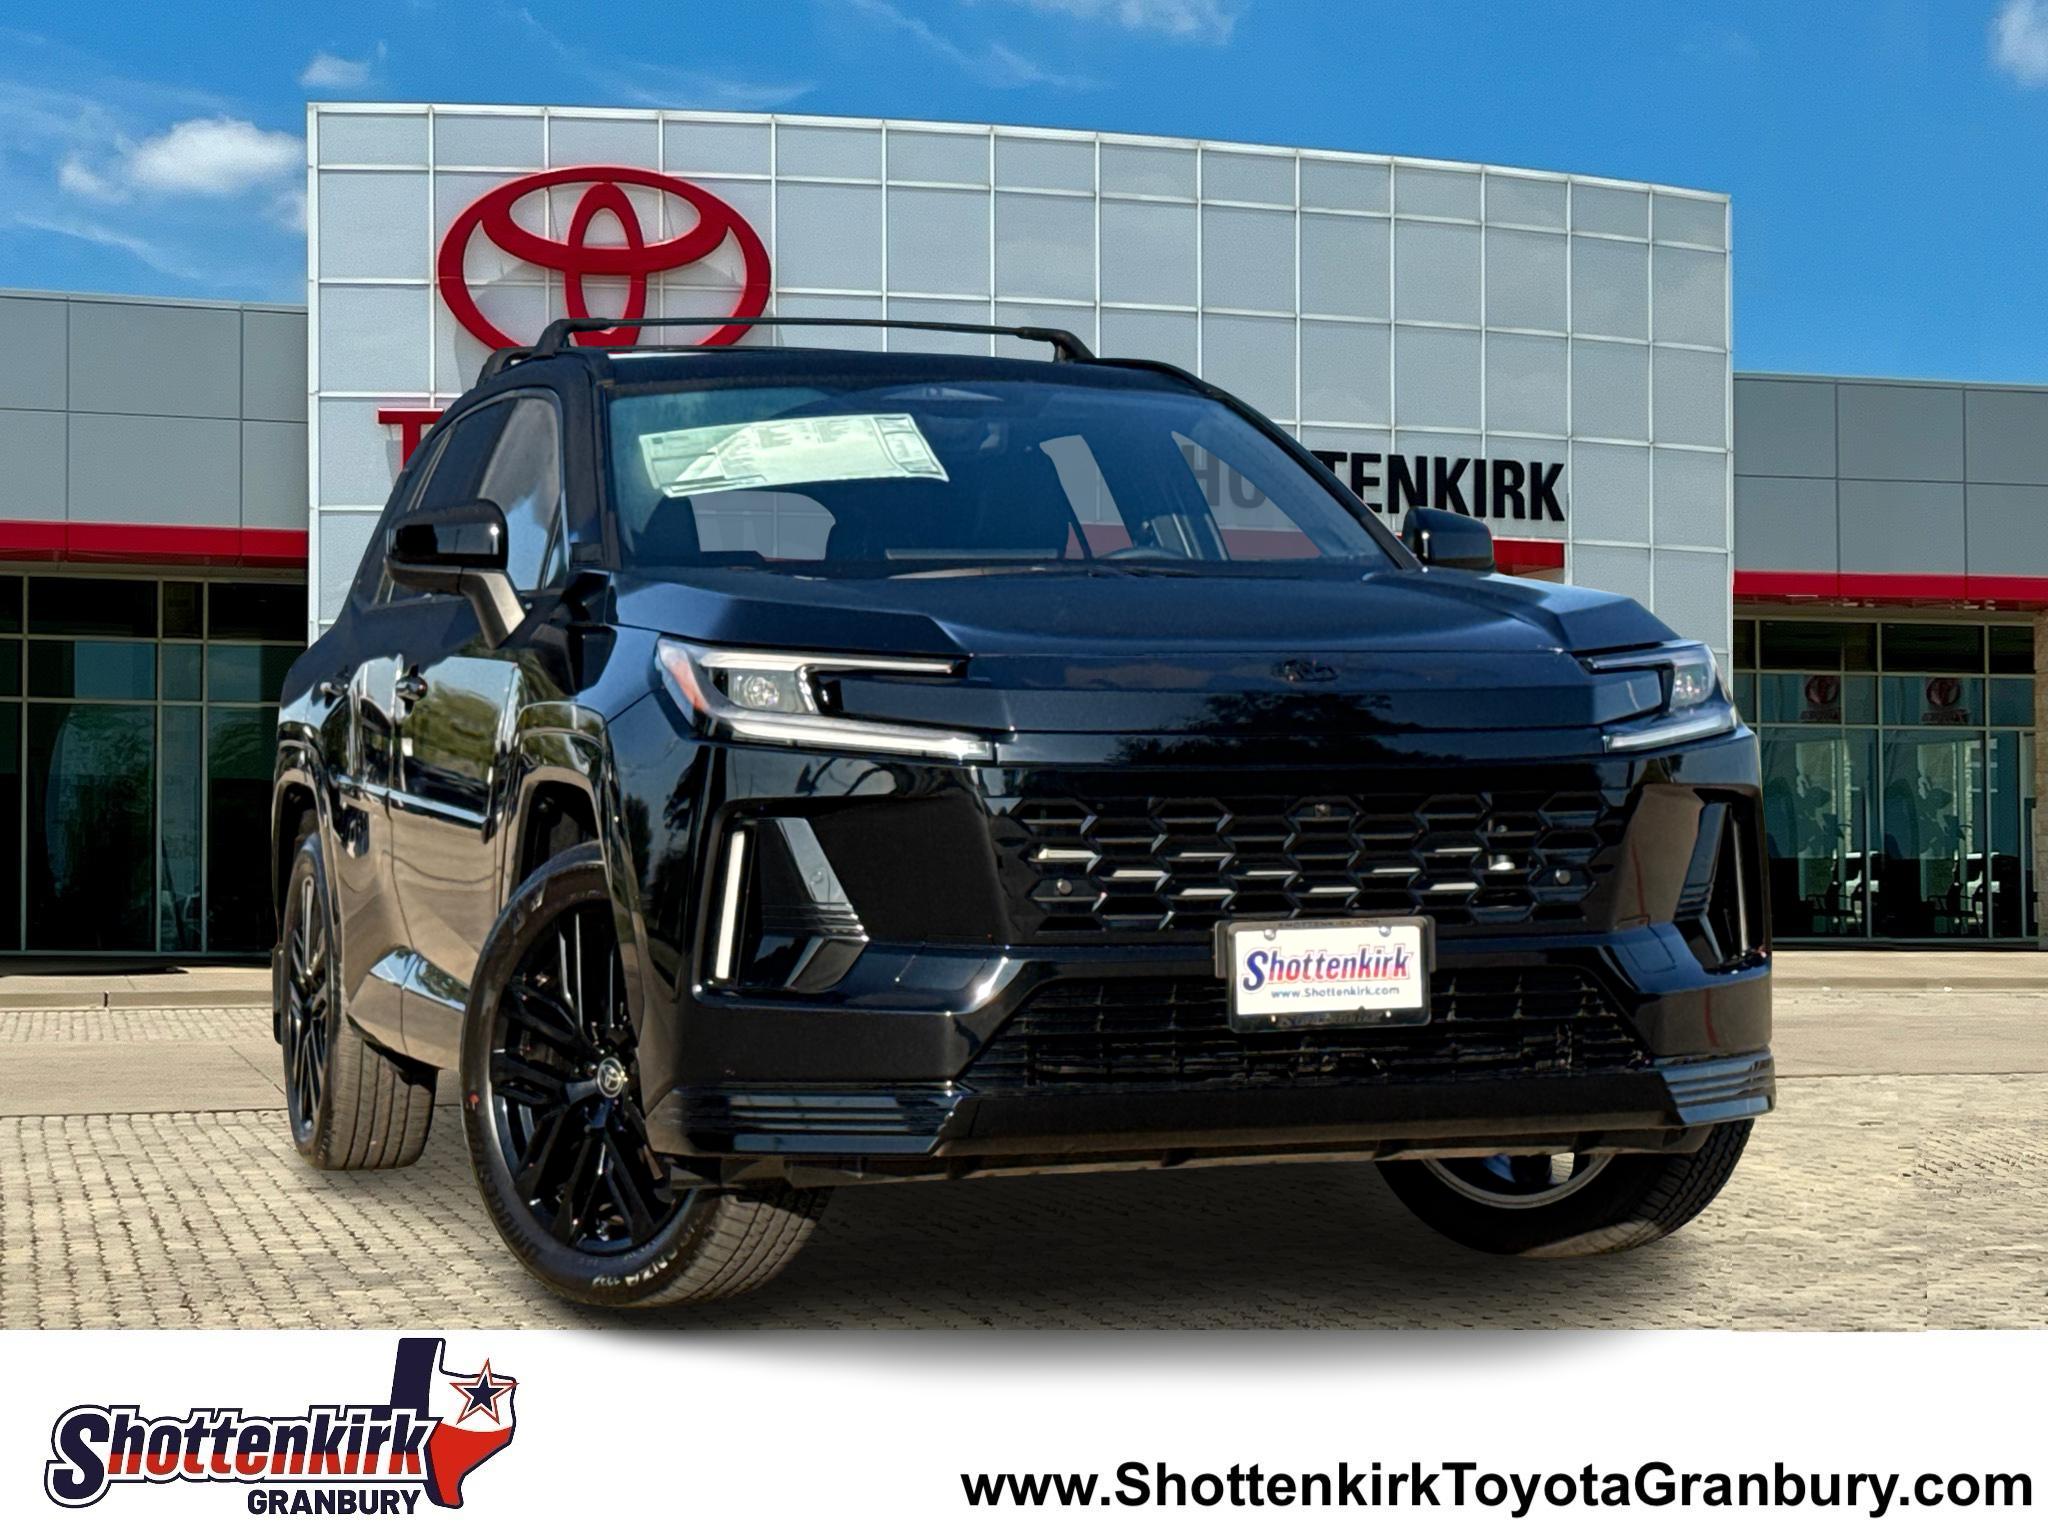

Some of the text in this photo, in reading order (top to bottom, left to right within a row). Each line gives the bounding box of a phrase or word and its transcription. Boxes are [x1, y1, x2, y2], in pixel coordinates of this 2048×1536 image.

[1182, 445, 1566, 522] HTENKIRK
[1242, 945, 1411, 992] Shottenkirk
[1270, 985, 1400, 999] www.Shottenkirk.com
